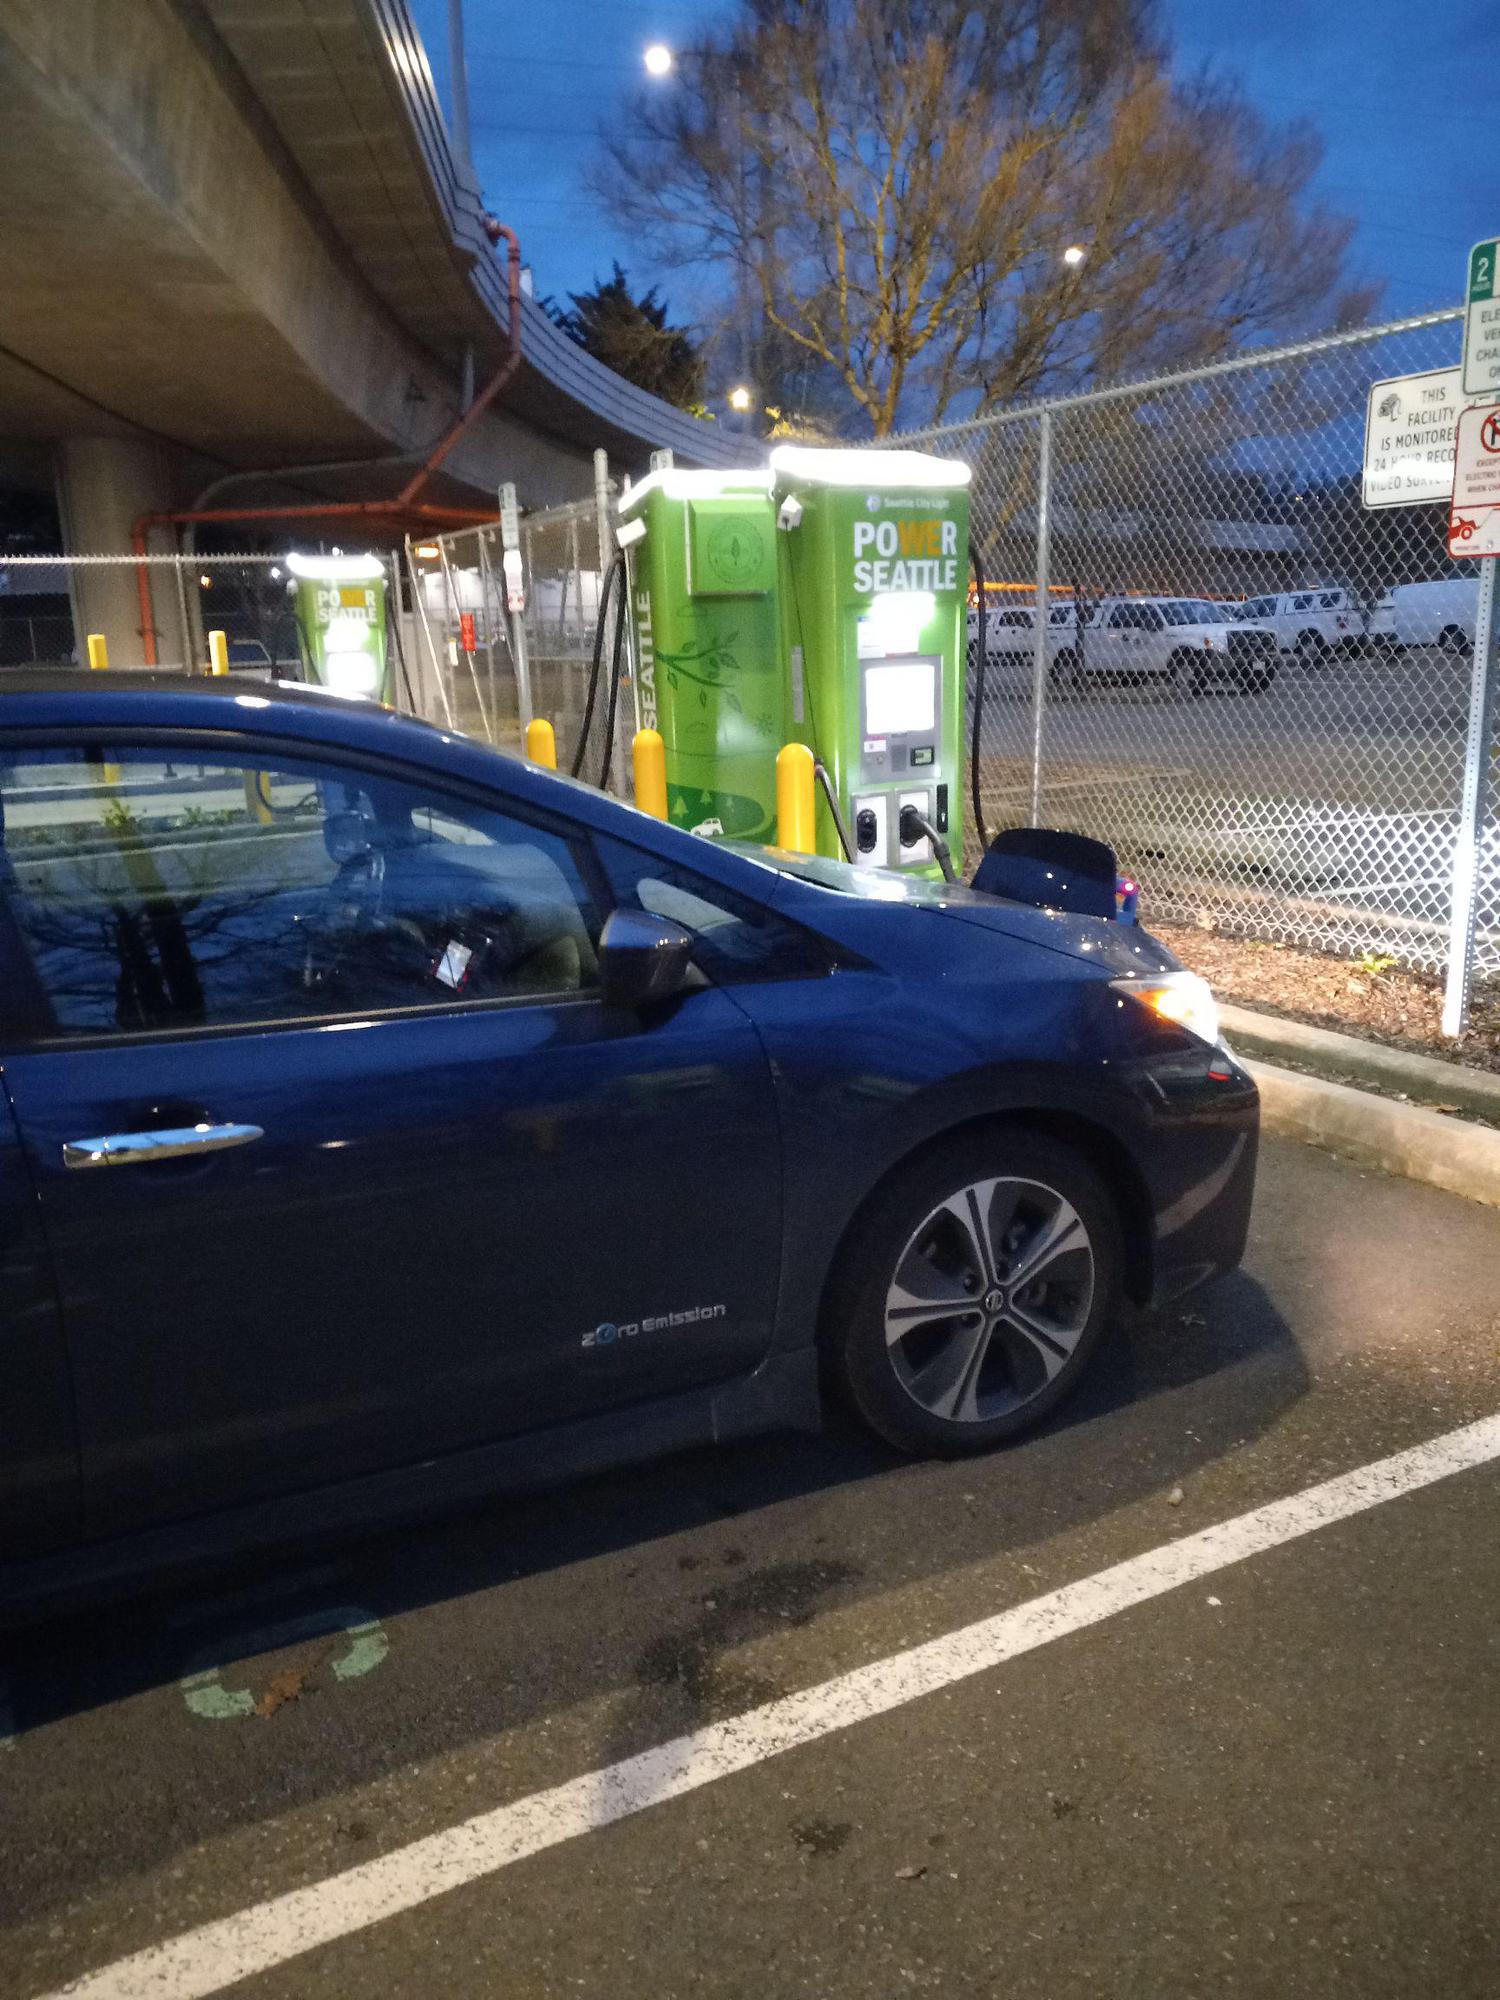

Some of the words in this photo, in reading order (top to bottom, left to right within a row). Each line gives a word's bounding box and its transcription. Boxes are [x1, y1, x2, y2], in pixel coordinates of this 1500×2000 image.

[1477, 257, 1489, 282] 2
[1422, 387, 1446, 403] THIS
[1408, 407, 1456, 426] FACILITY
[1381, 437, 1391, 451] IS
[1374, 459, 1387, 472] 24
[854, 520, 957, 558] POWER
[853, 559, 958, 593] SEATTLE
[637, 590, 658, 731] SEATTLE
[642, 1304, 727, 1332] Emission
